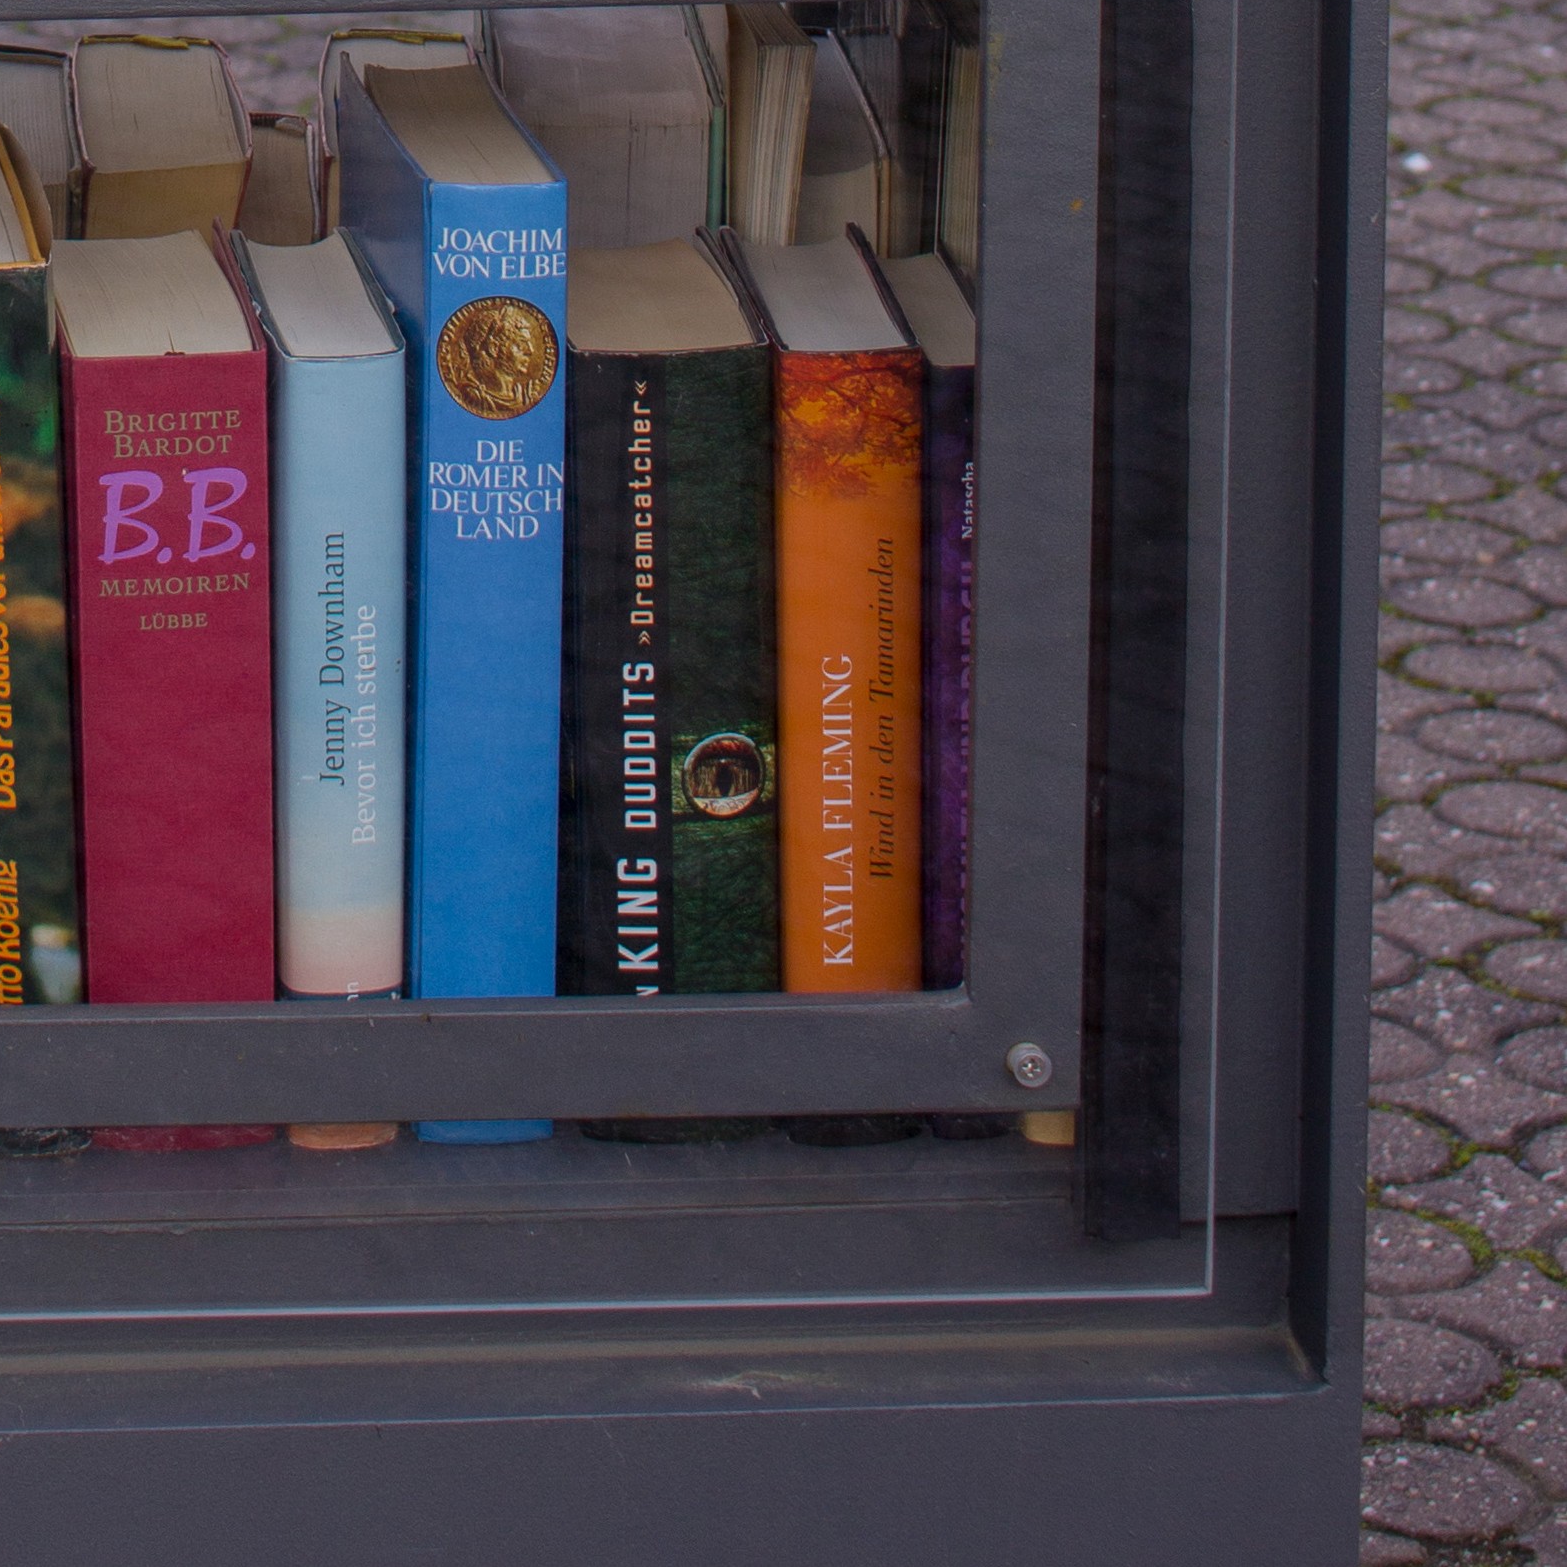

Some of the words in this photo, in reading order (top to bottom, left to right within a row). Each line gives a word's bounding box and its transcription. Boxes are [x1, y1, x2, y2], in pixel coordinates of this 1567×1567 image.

[438, 227, 564, 255] JOACHIM
[432, 251, 490, 279] VON
[500, 251, 567, 280] ELBE
[104, 409, 242, 433] BRIGITTE
[113, 435, 232, 459] BARDOT
[476, 439, 524, 463] DIE
[428, 461, 527, 489] RÖMER
[538, 461, 564, 485] IN
[431, 487, 564, 514] DEUTSCH
[98, 466, 256, 564] B.B.
[456, 516, 539, 540] LAND
[99, 572, 250, 597] MEMOIREN
[139, 612, 208, 631] LÜBBE
[318, 531, 345, 687] Downham
[319, 698, 351, 786] Jenny
[623, 662, 658, 829] DUDDITS
[821, 654, 854, 832] FLEMING
[617, 858, 659, 971] KING
[823, 844, 854, 966] KAYLA
